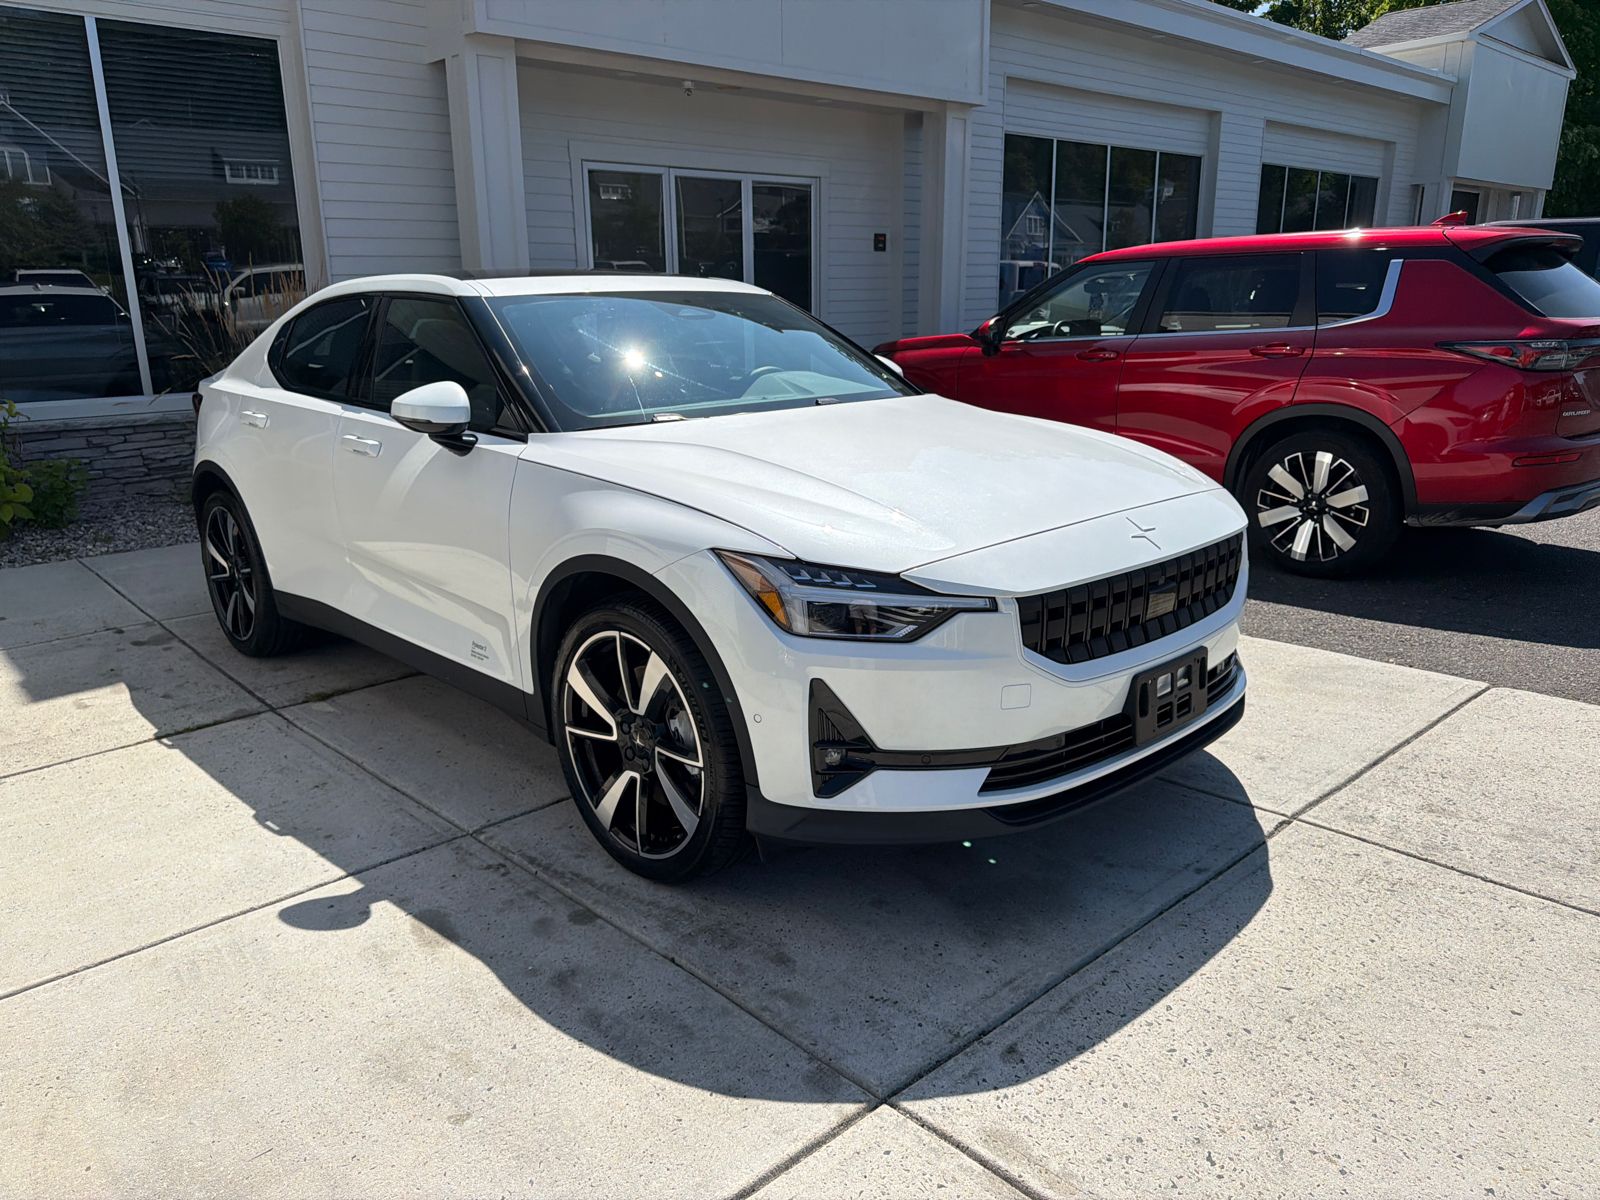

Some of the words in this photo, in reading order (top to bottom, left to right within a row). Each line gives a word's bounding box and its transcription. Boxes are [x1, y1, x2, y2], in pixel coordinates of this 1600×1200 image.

[1562, 409, 1591, 417] OUTLANDER
[677, 671, 709, 741] MICHELIN
[706, 748, 715, 787] PRIMACY
